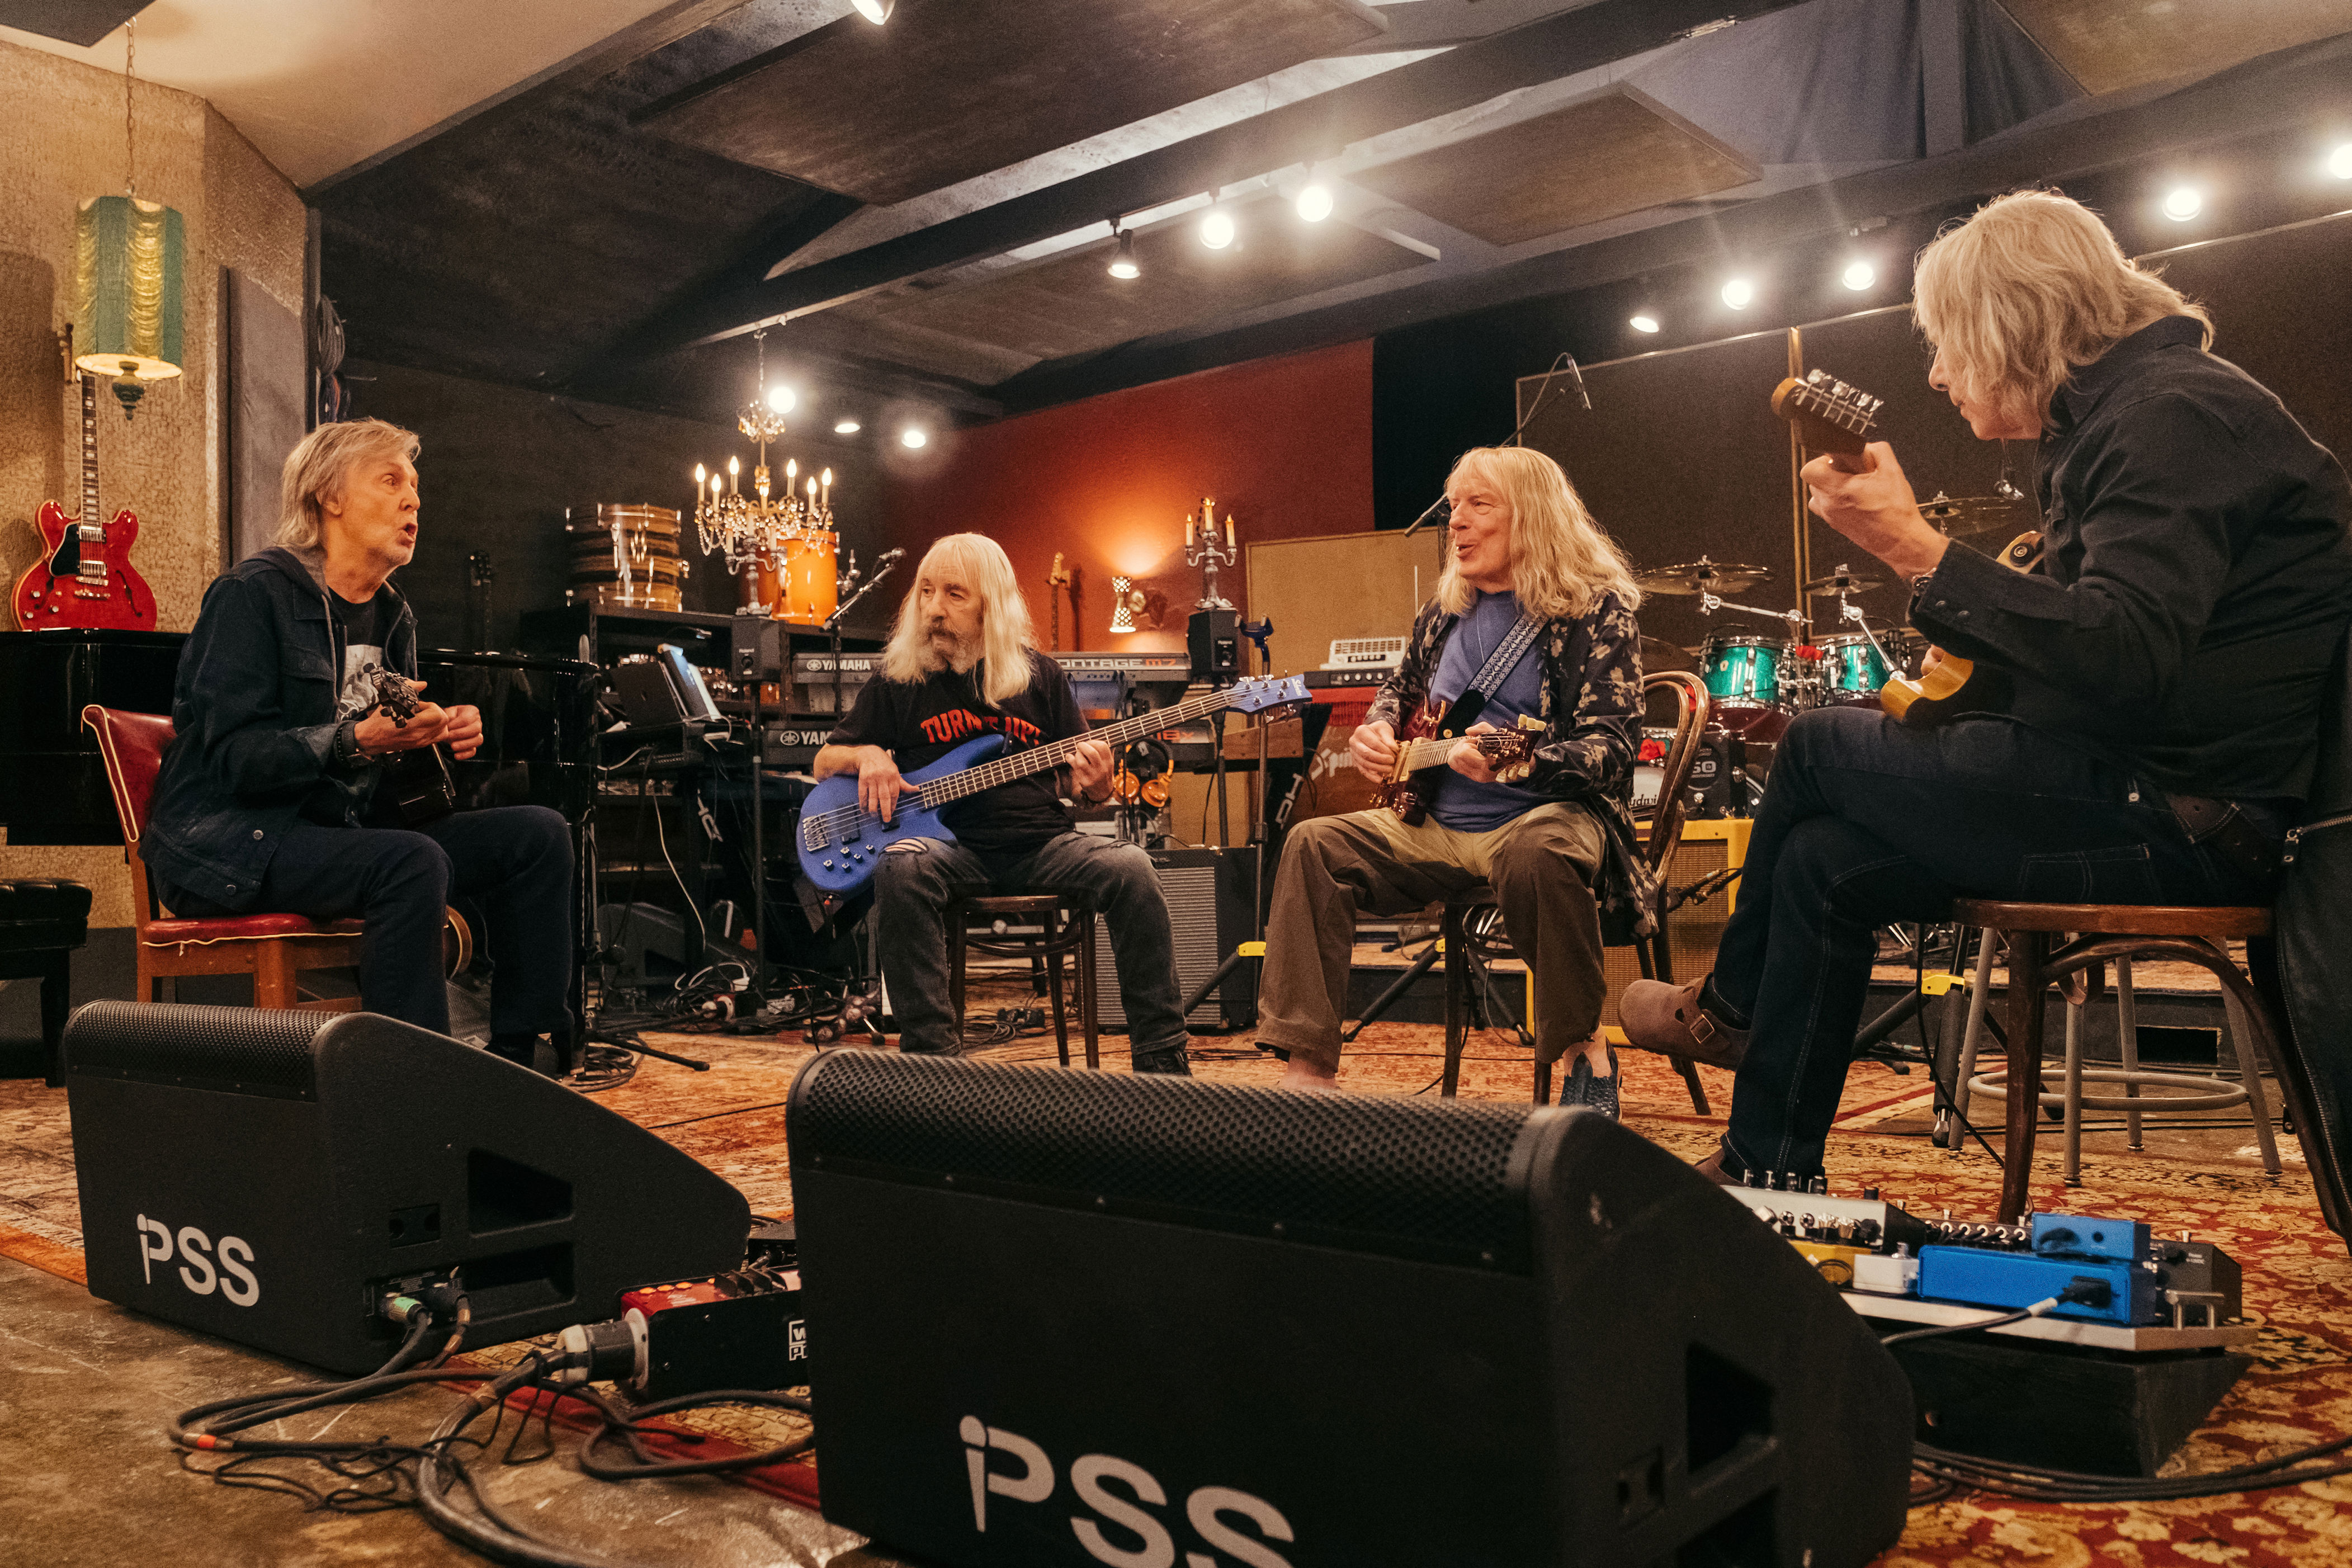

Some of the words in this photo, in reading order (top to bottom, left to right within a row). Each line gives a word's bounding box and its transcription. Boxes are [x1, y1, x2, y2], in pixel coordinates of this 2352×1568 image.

[822, 659, 871, 670] YAMAHA
[920, 709, 983, 743] TURN
[136, 1213, 259, 1307] PSS
[960, 1415, 1293, 1568] PSS
